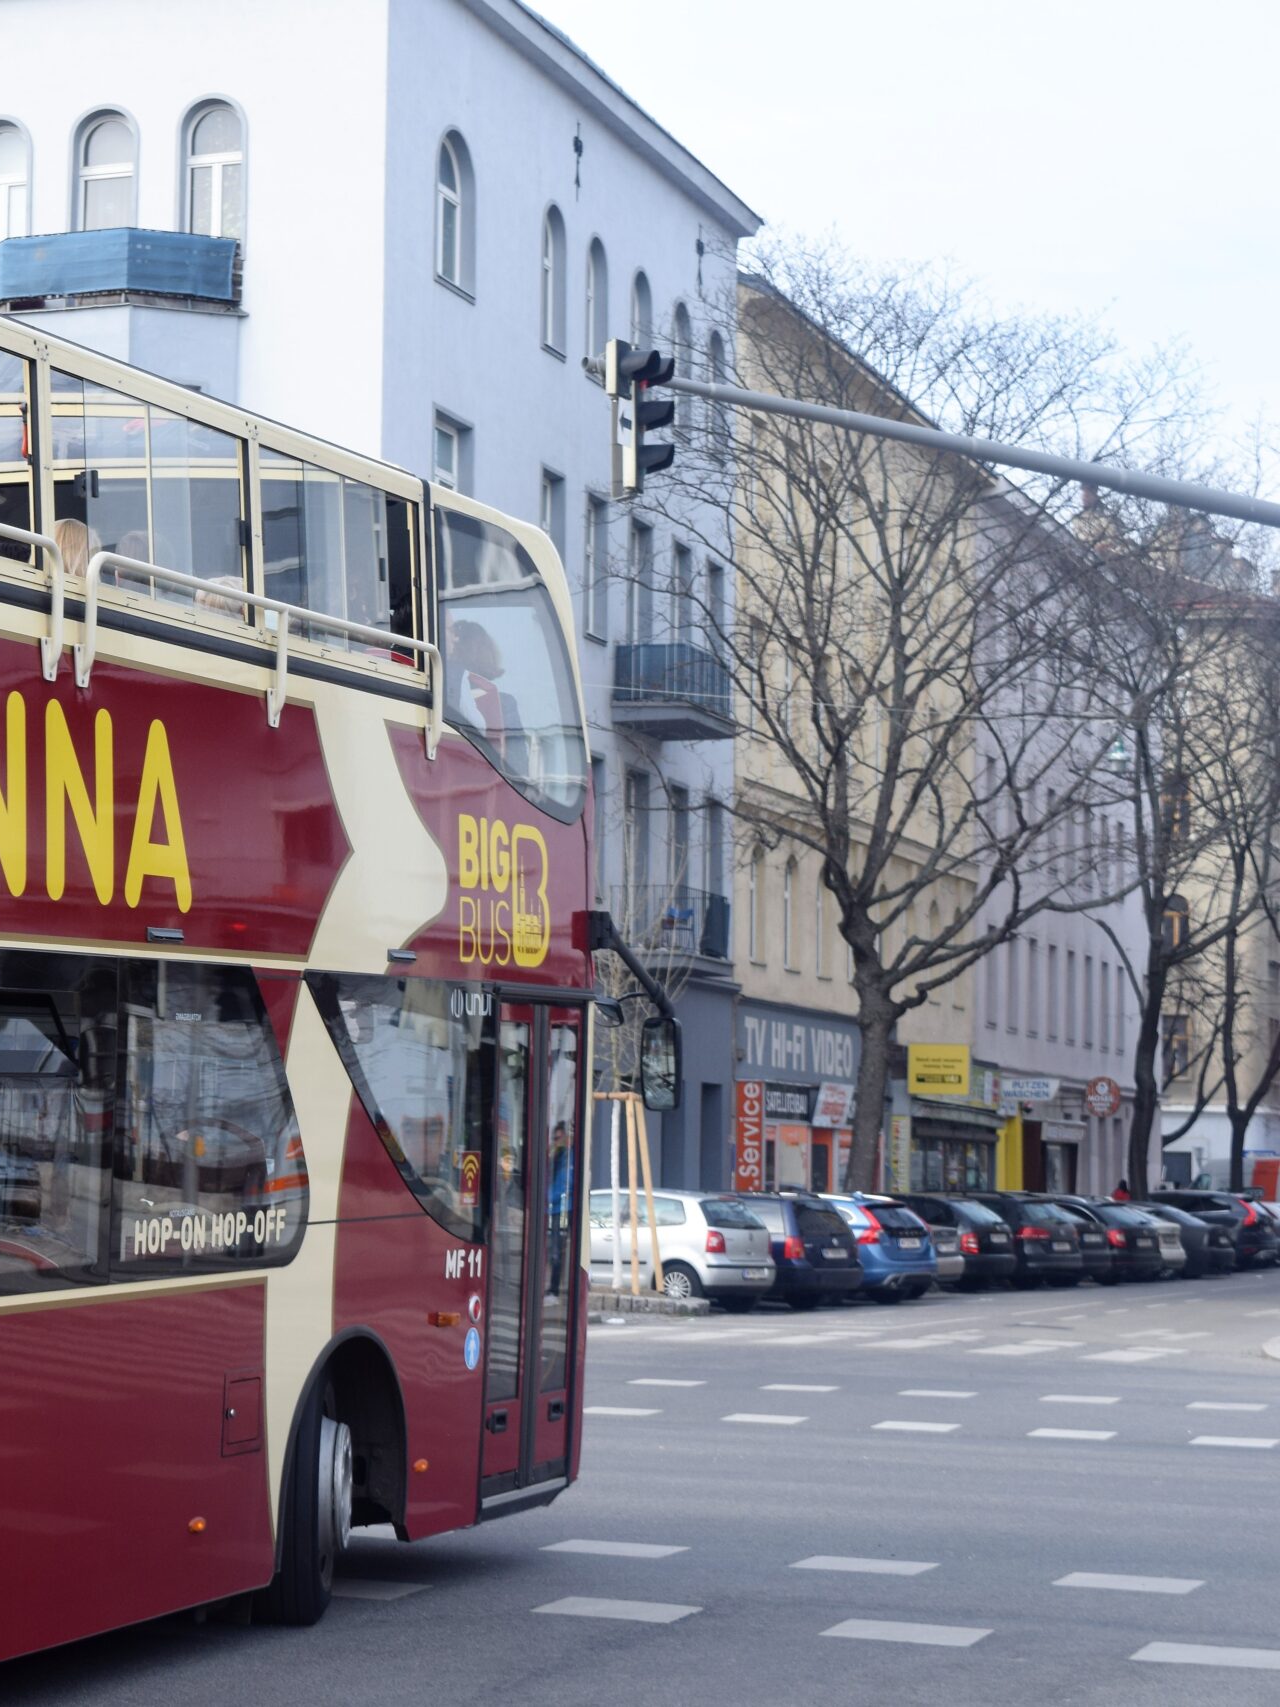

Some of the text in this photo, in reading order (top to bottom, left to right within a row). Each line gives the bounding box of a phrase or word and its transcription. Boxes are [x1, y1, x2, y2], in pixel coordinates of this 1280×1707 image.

[458, 814, 511, 893] BIG
[459, 896, 511, 967] BUS
[744, 1016, 853, 1078] TV HI-FI VIDEO
[134, 1208, 287, 1256] HOP-ON HOP-OFF
[445, 1248, 482, 1279] MF 11
